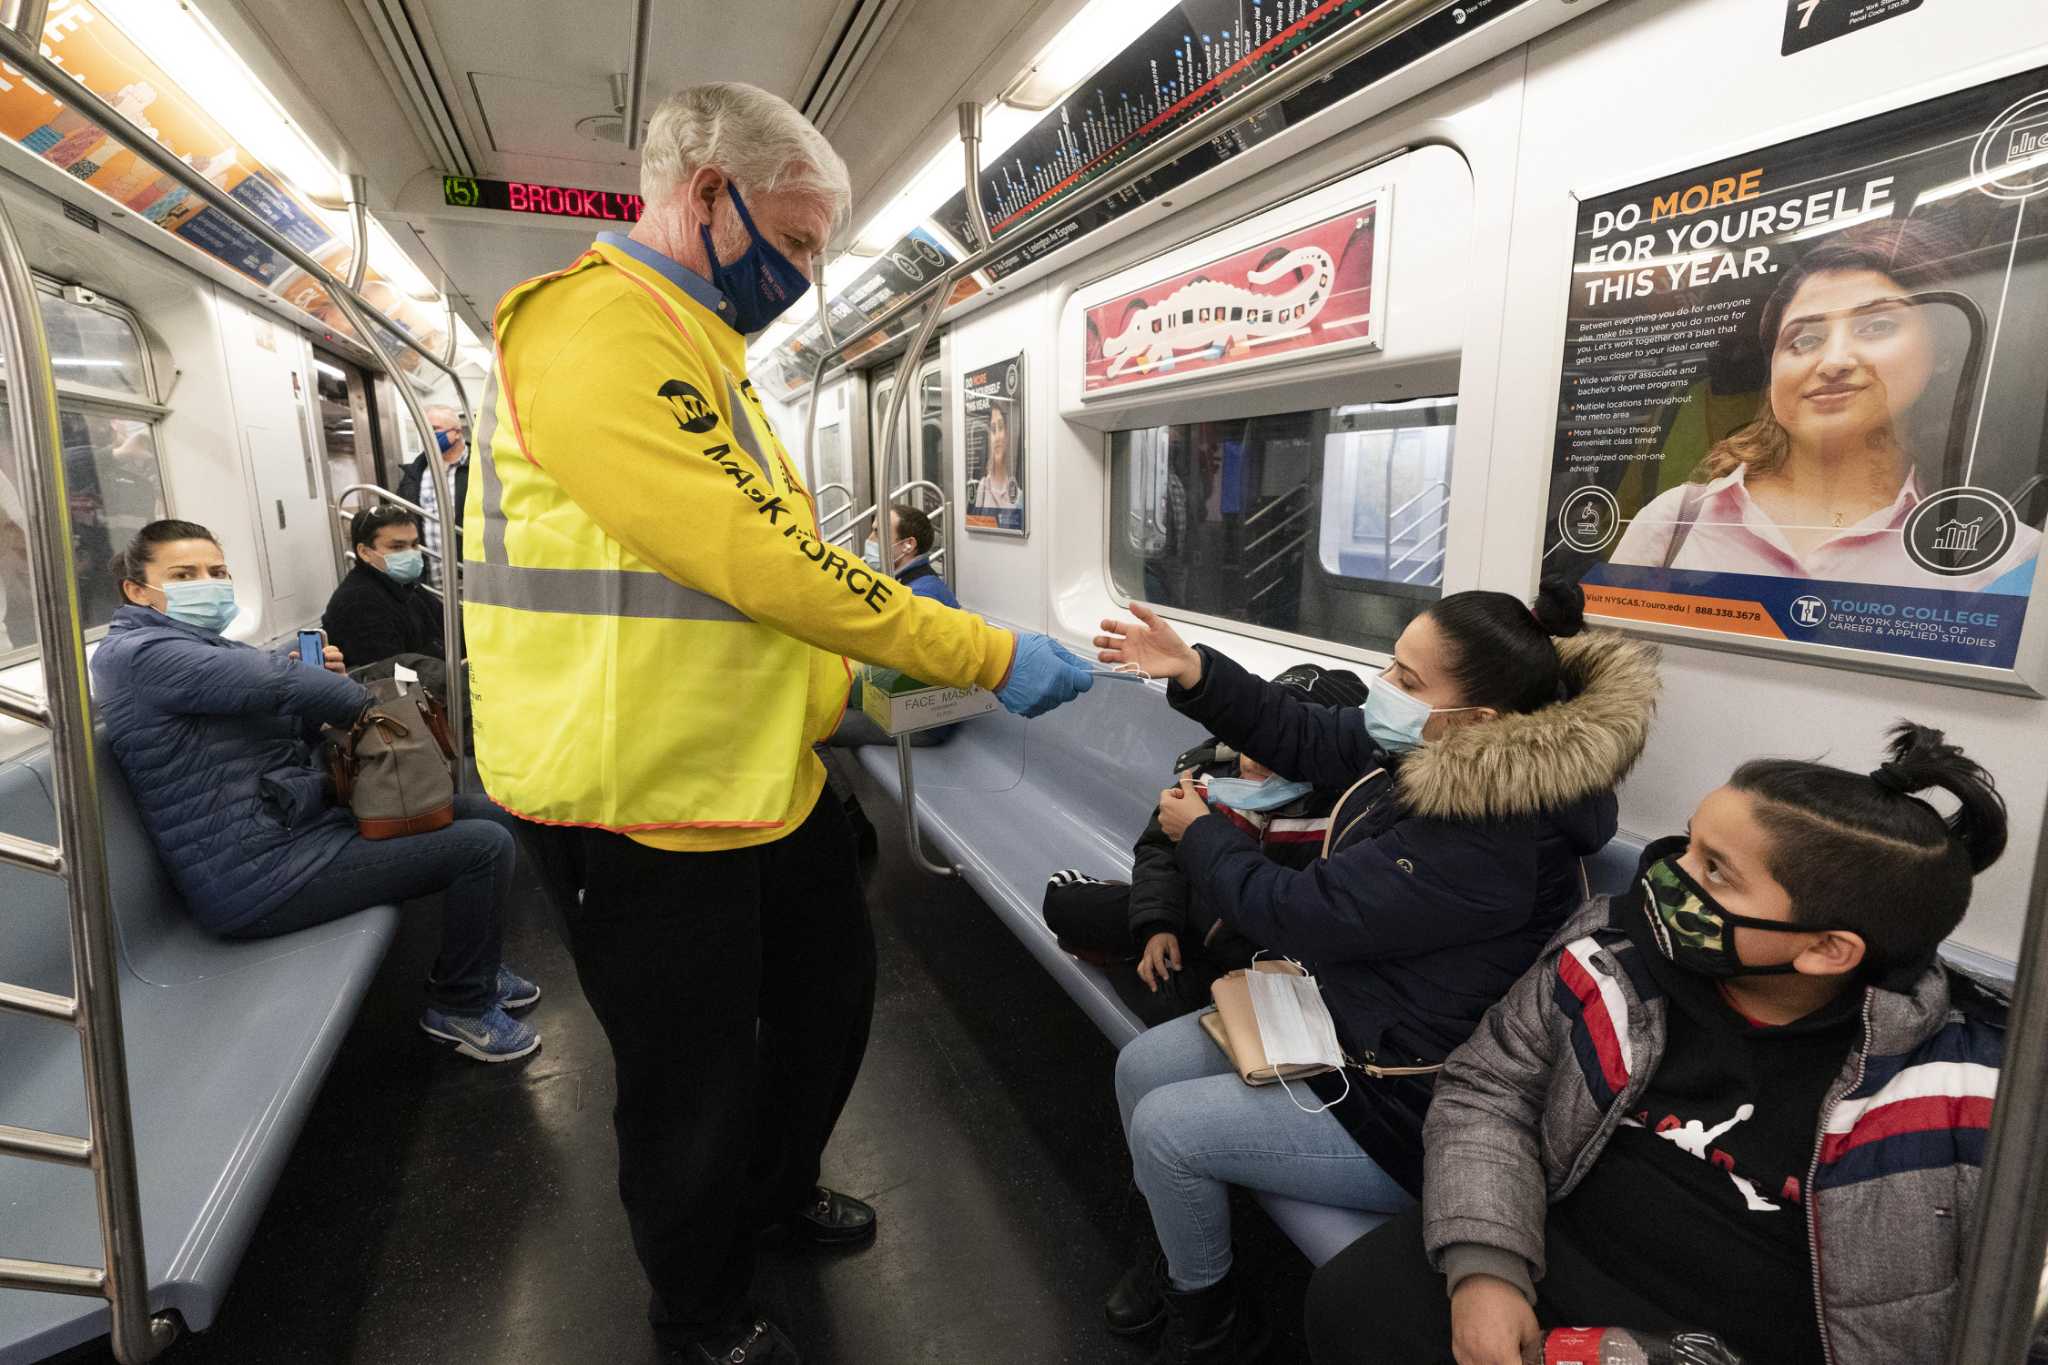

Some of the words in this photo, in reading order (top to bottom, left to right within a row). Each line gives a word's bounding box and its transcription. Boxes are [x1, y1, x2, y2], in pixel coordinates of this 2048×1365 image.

[1592, 203, 1641, 239] DO
[1651, 167, 1764, 224] MORE
[1589, 234, 1656, 266] FOR
[1585, 269, 1655, 306] THIS
[1665, 246, 1779, 291] YEAR.
[1579, 320, 1613, 332] Between
[1614, 313, 1657, 327] everything
[1659, 310, 1675, 321] you
[1676, 306, 1689, 316] do
[1691, 303, 1705, 314] for
[1707, 298, 1751, 312] everyone
[1619, 326, 1633, 337] this
[1635, 324, 1649, 335] the
[1650, 322, 1670, 334] year
[1671, 319, 1688, 330] you
[1690, 315, 1702, 326] do
[1704, 313, 1729, 324] more
[1732, 310, 1747, 320] for
[1614, 339, 1634, 349] work
[1695, 326, 1716, 339] plan
[1718, 323, 1738, 334] that
[1575, 356, 1592, 366] gets
[1593, 354, 1608, 363] you
[1609, 350, 1634, 361] closer
[1635, 349, 1644, 357] to
[1645, 346, 1665, 357] your
[1666, 342, 1688, 353] ideal
[1690, 339, 1720, 351] career.
[1579, 376, 1599, 385] Wide
[1601, 374, 1627, 385] variety
[1628, 371, 1637, 380] of
[1638, 369, 1678, 379] associate
[1679, 366, 1697, 374] and
[1577, 385, 1616, 395] bachelor's
[1618, 382, 1646, 393] degree
[1647, 379, 1689, 390] programs
[1576, 401, 1605, 411] Multiple
[1606, 399, 1642, 408] locations
[1643, 395, 1692, 406] throughout
[1575, 413, 1587, 421] the
[1588, 412, 1611, 420] metro
[1573, 428, 1592, 436] More
[1593, 426, 1627, 437] flexibility
[1629, 424, 1662, 435] through
[1572, 439, 1612, 447] convenient
[1614, 437, 1633, 445] class
[1634, 436, 1657, 444] times
[1570, 453, 1617, 461] Personalized
[1618, 453, 1666, 461] one-on-one
[1569, 465, 1599, 473] advising
[1586, 593, 1603, 602] Visit
[1604, 596, 1685, 612] NYSCAS.Touro.edu
[1831, 600, 1896, 616] TOURO
[1902, 606, 2000, 627] COLLEGE
[1829, 613, 1857, 622] NEW
[1860, 616, 1891, 627] YORK
[1894, 619, 1945, 633] SCHOOL
[1949, 625, 1969, 635] OF
[1828, 621, 1873, 634] CAREER
[1876, 626, 1883, 634] &
[1887, 628, 1938, 641] APPLIED
[1941, 634, 1998, 648] STUDIES
[904, 694, 935, 711] FACE
